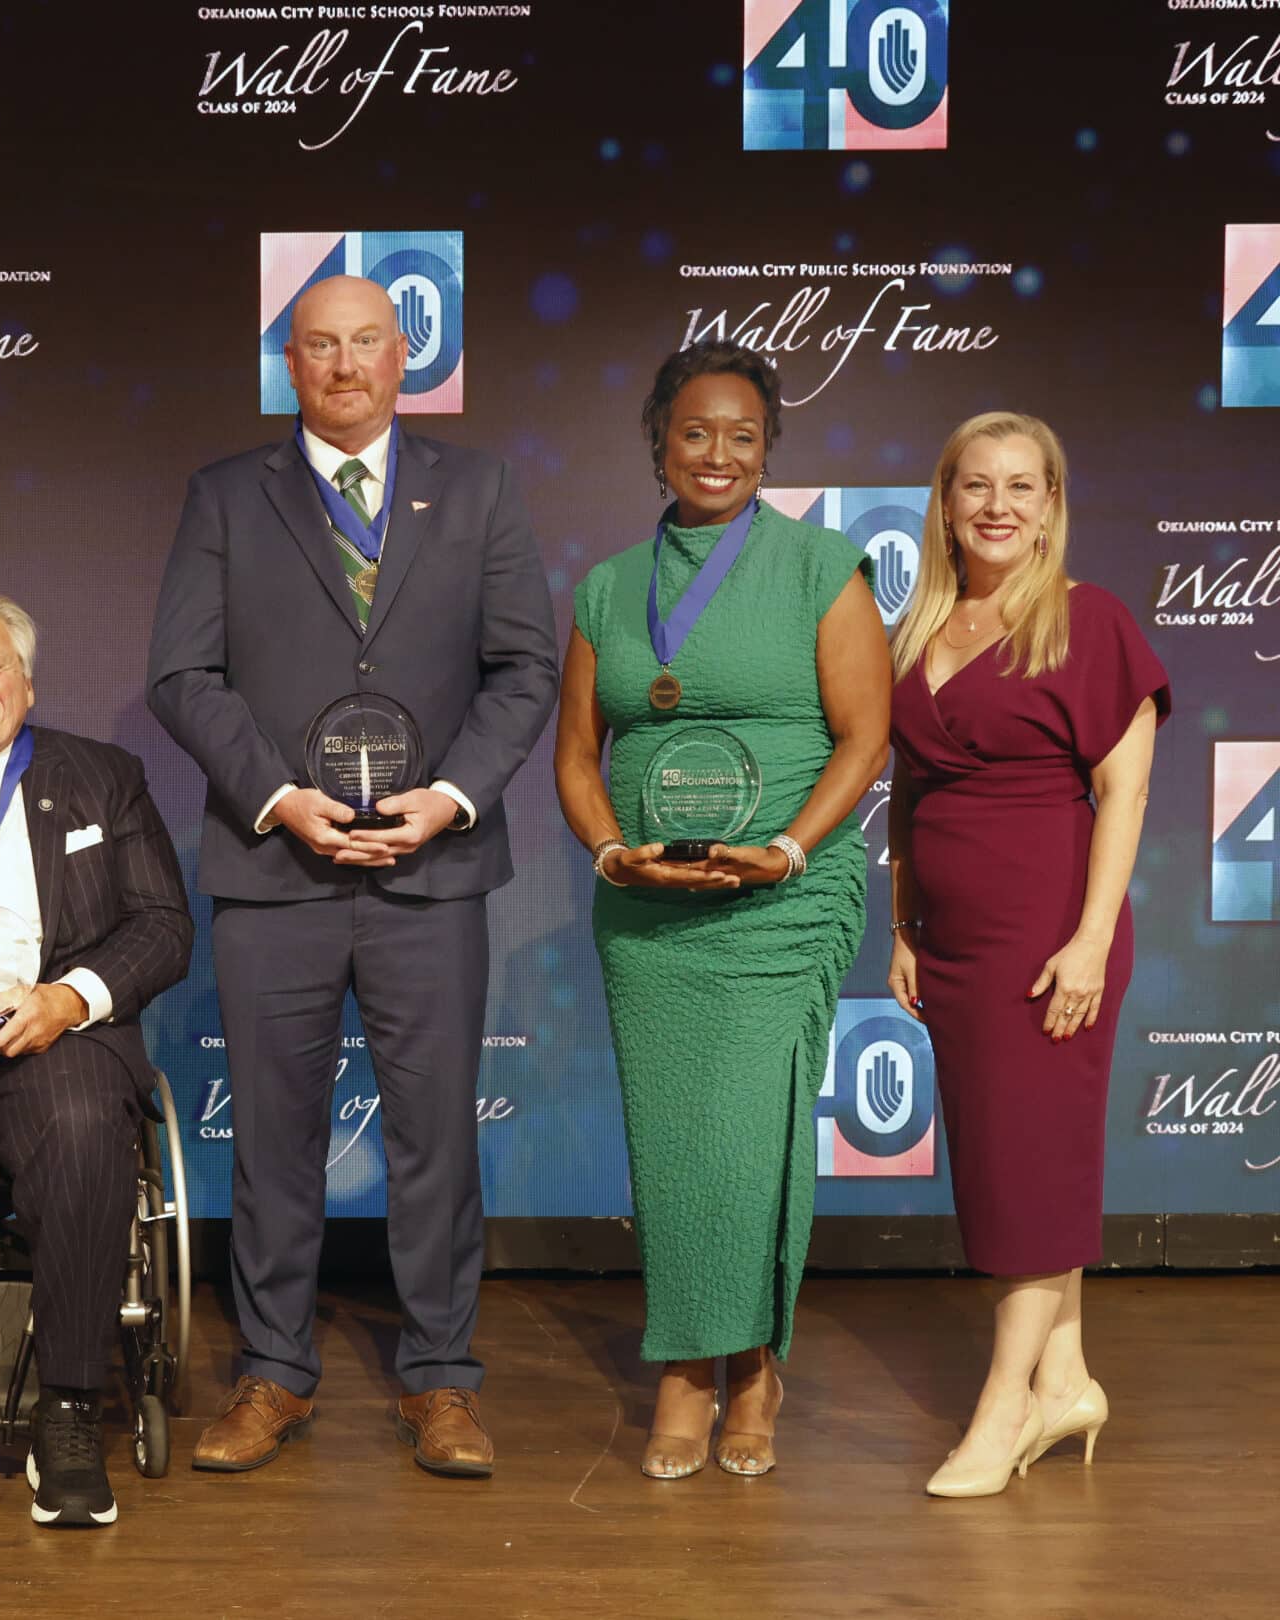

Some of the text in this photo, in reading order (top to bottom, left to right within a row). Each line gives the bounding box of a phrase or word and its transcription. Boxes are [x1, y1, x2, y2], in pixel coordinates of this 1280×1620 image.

[198, 5, 531, 19] OKLAHOMA CITY PUBLIC SCHOOLS FOUNDATION
[1166, 34, 1280, 87] Wal
[199, 20, 518, 150] Wall of Fame
[1165, 91, 1265, 104] CLASS OF 2024
[197, 101, 296, 114] CLASS OF 2024
[680, 263, 1012, 277] OKLAHOMA CITY PUBLIC SCHOOLS FOUNDATION
[679, 278, 998, 407] Wall of Fame
[1157, 519, 1274, 533] OKLAHOMA CITY
[1155, 612, 1254, 625] CLASS OF 2024
[344, 743, 406, 753] FOUNDATION
[680, 777, 743, 786] FOUNDATION
[482, 1036, 526, 1047] ATION
[1148, 1032, 1227, 1044] OKLAHOMA
[1230, 1031, 1263, 1044] CITY
[200, 1127, 233, 1139] CLAS
[1146, 1121, 1244, 1134] CLASS OF 2024
